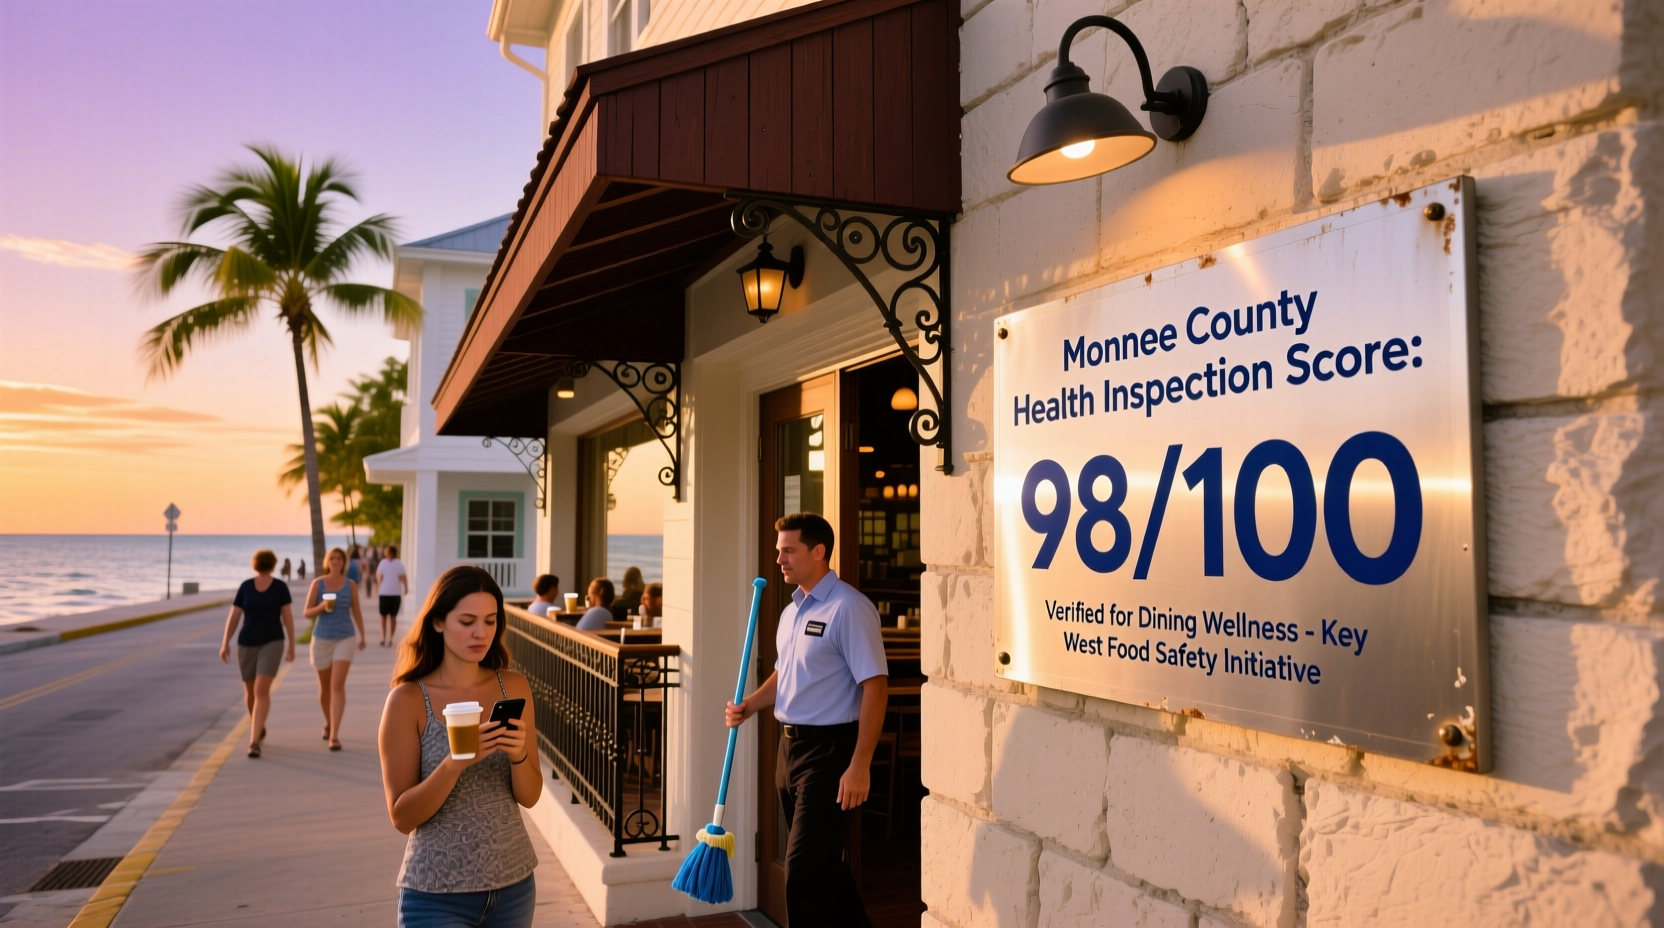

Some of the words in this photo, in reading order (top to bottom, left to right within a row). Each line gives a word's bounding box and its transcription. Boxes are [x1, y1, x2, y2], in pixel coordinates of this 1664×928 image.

[1063, 323, 1178, 372] Monnee
[1186, 289, 1318, 345] County
[1014, 384, 1095, 426] Health
[1104, 356, 1273, 418] Inspection
[1286, 335, 1423, 386] Score:
[1021, 430, 1424, 586] 98/100
[1045, 599, 1105, 625] Verified
[1109, 603, 1134, 627] for
[1138, 605, 1197, 640] Dining
[1202, 610, 1299, 643] Wellness
[1321, 618, 1369, 656] Key
[1063, 631, 1103, 656] West
[1108, 636, 1150, 663] Food
[1155, 642, 1218, 677] Safety
[1224, 647, 1322, 687] Initiative
